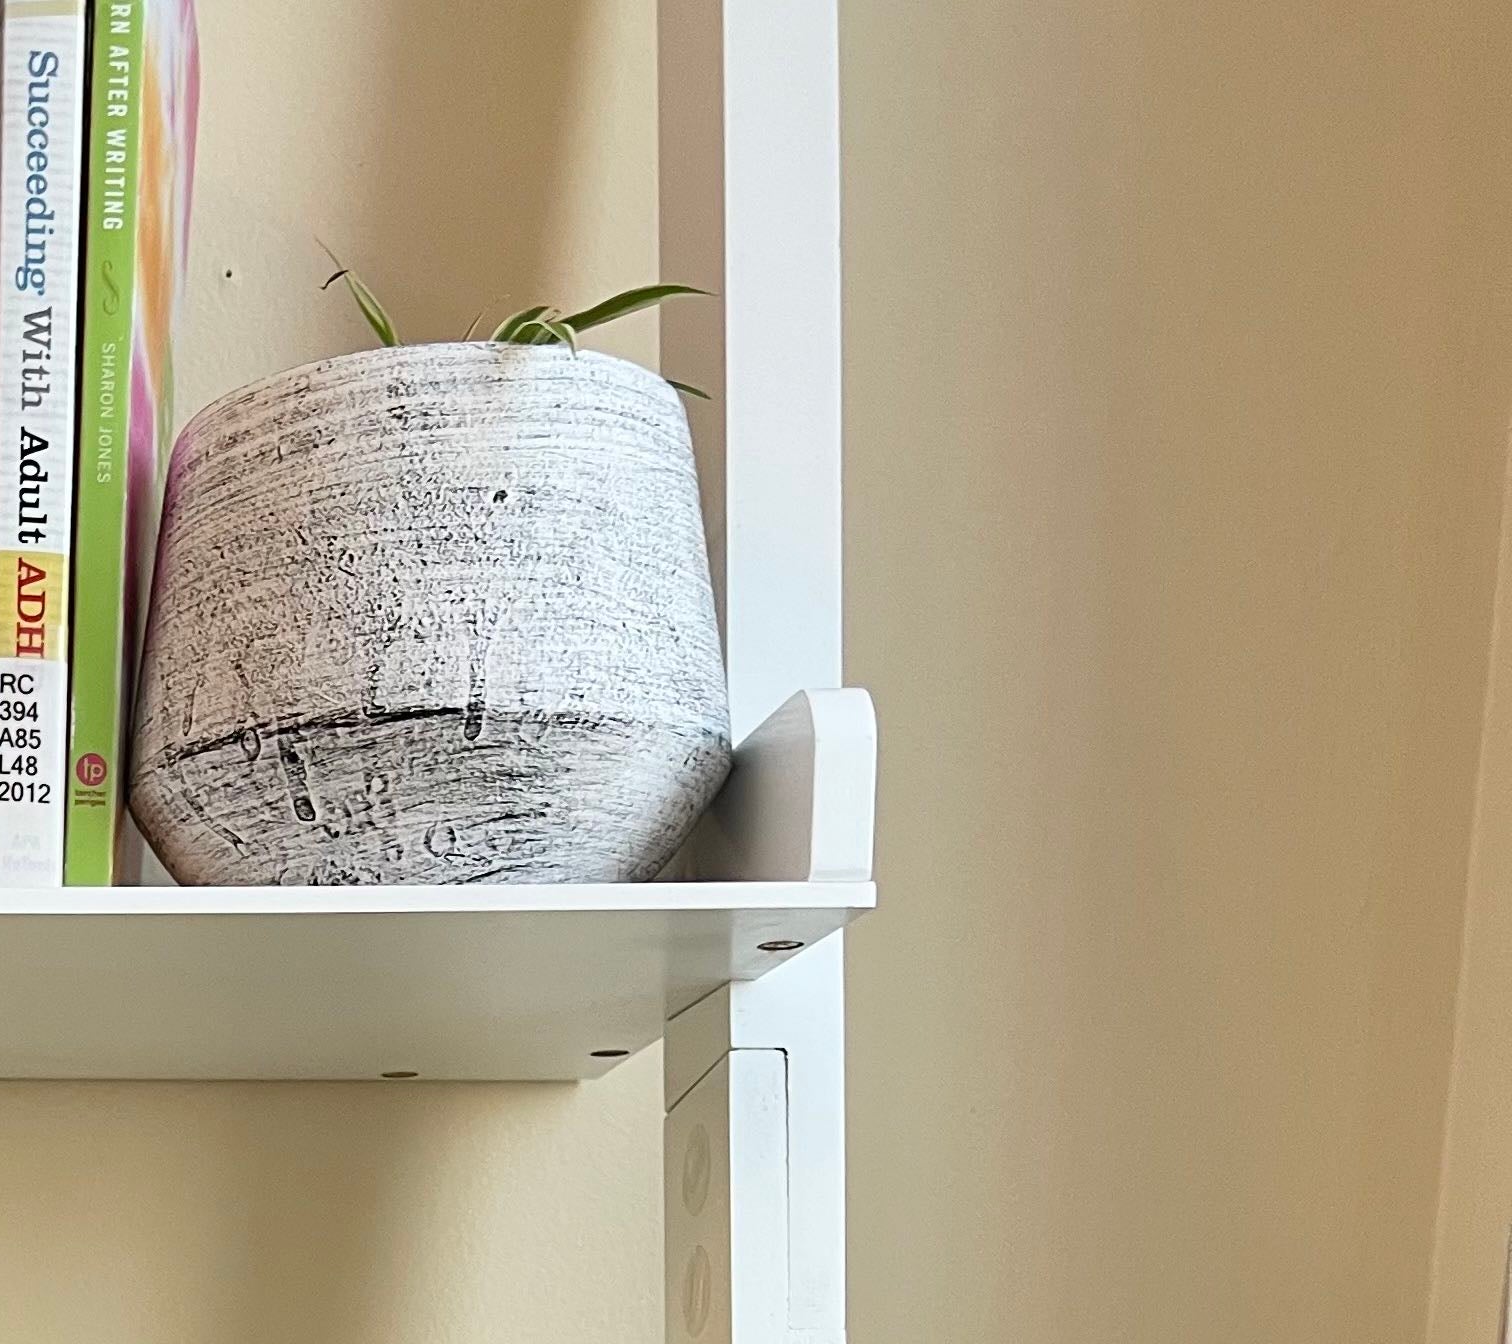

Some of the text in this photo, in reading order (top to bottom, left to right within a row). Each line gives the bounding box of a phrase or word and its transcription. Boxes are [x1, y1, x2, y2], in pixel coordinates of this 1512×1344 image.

[107, 45, 130, 117] AFTER
[103, 129, 127, 230] WRITING
[15, 50, 59, 659] Succeeding With Adult ADH
[96, 343, 117, 483] SHARON JONES
[0, 673, 34, 695] RC
